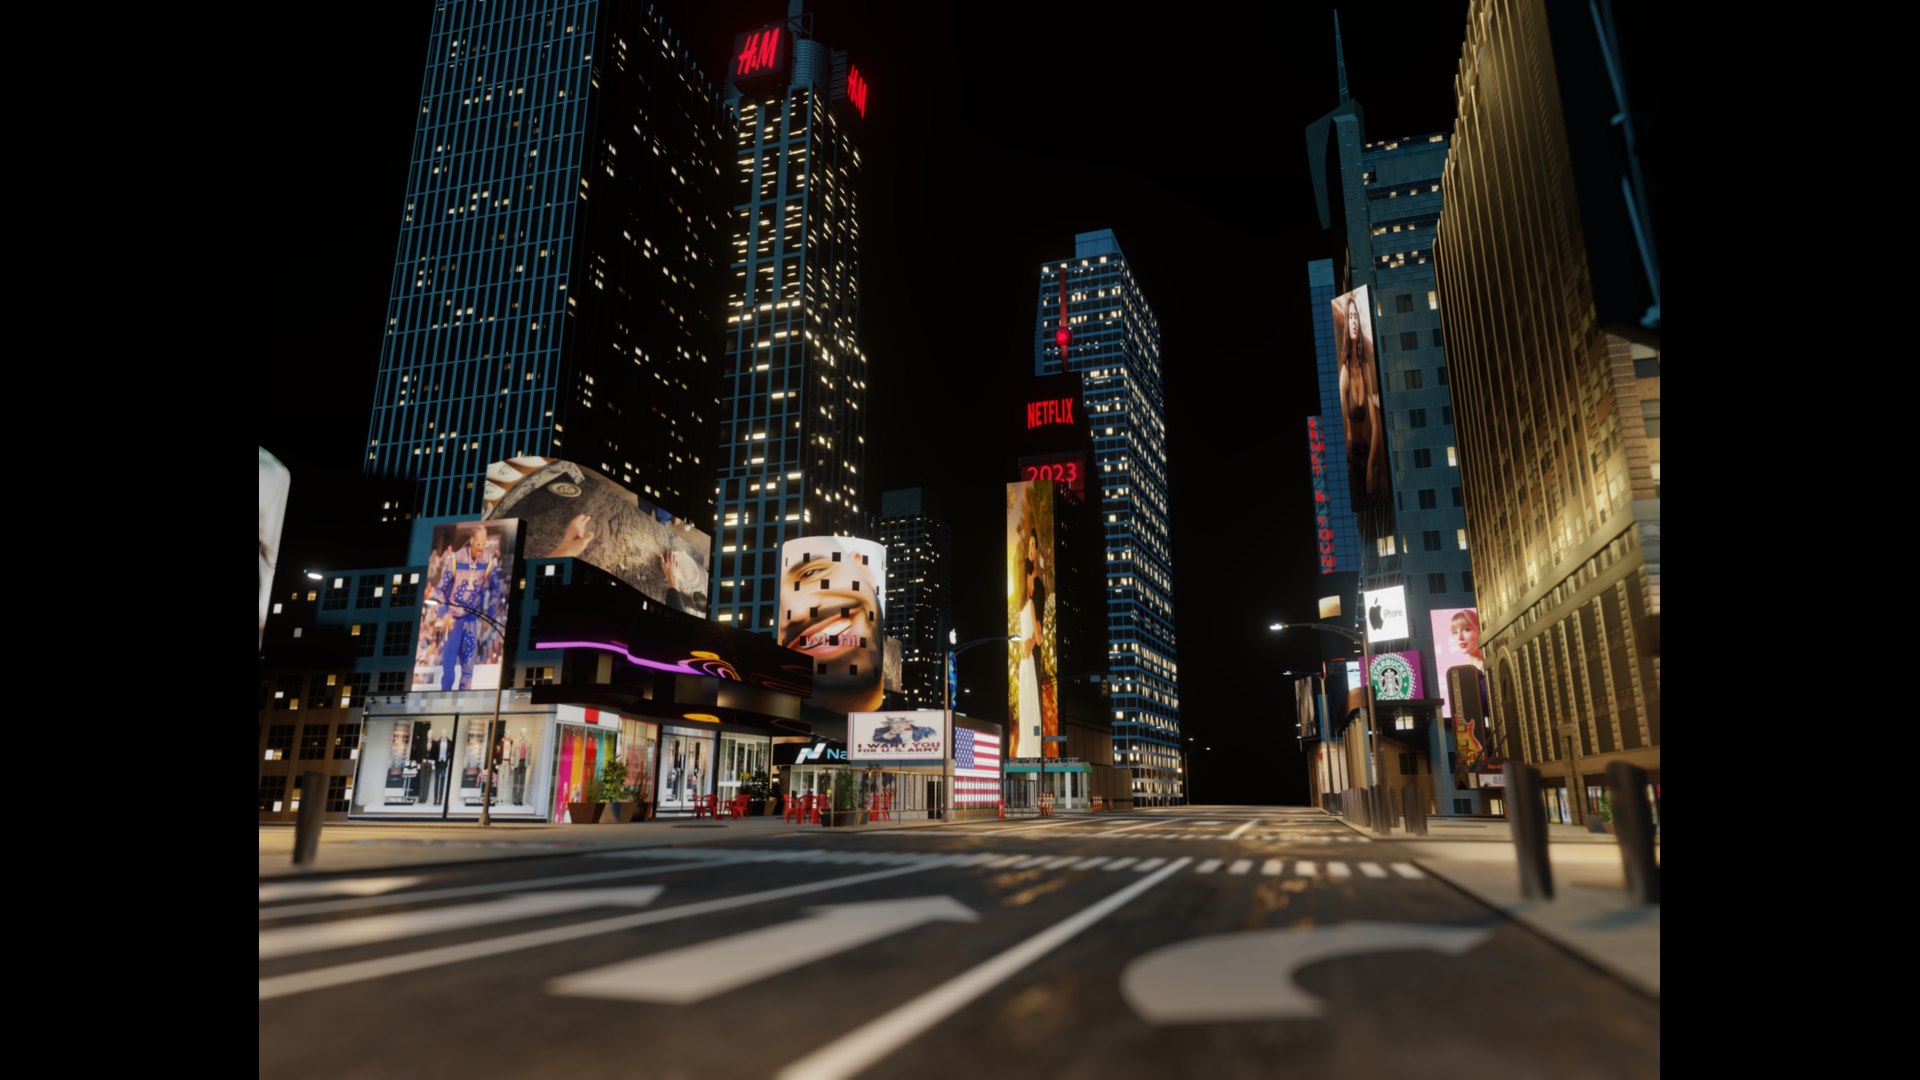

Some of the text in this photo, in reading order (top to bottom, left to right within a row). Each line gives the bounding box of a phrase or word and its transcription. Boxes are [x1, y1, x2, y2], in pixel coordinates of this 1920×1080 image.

[737, 27, 779, 75] H&M
[1027, 398, 1074, 429] NETFLIX
[1308, 417, 1321, 477] ERNST
[1027, 462, 1077, 482] 2023
[1384, 609, 1403, 618] iPhone
[1372, 659, 1407, 680] STARBUCKS
